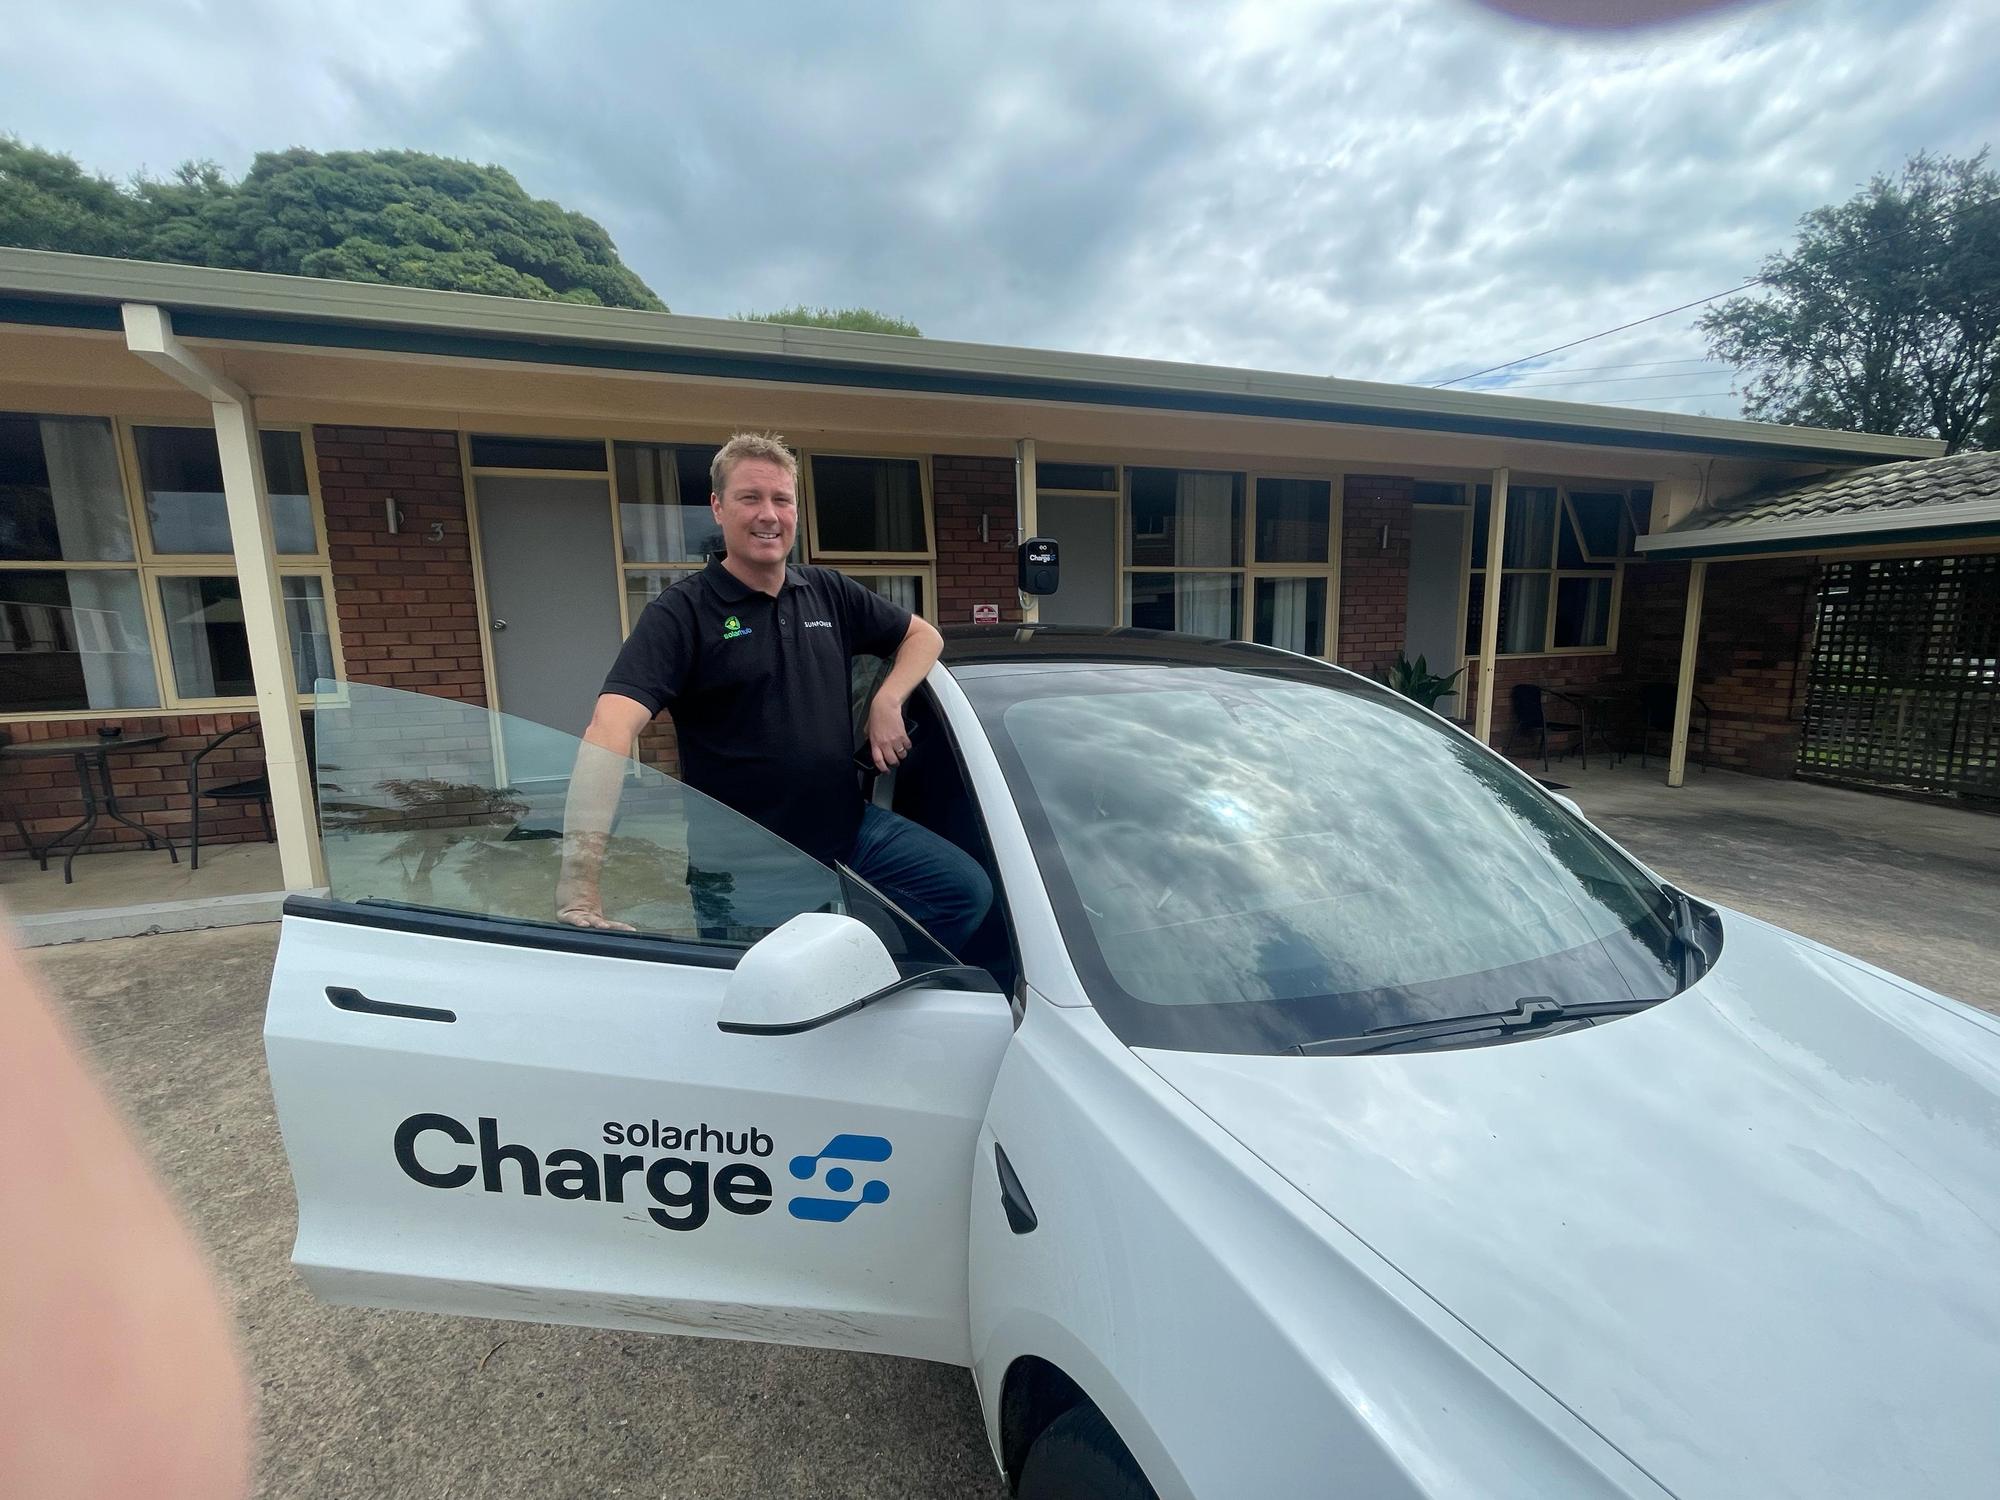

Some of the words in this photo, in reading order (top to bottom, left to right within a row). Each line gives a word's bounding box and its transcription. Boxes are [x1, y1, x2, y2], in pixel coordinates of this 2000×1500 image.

[428, 522, 444, 542] 3
[1029, 554, 1051, 563] Charge
[723, 627, 753, 640] solarhub
[603, 1116, 773, 1157] solarhub
[393, 1112, 774, 1232] Charge
